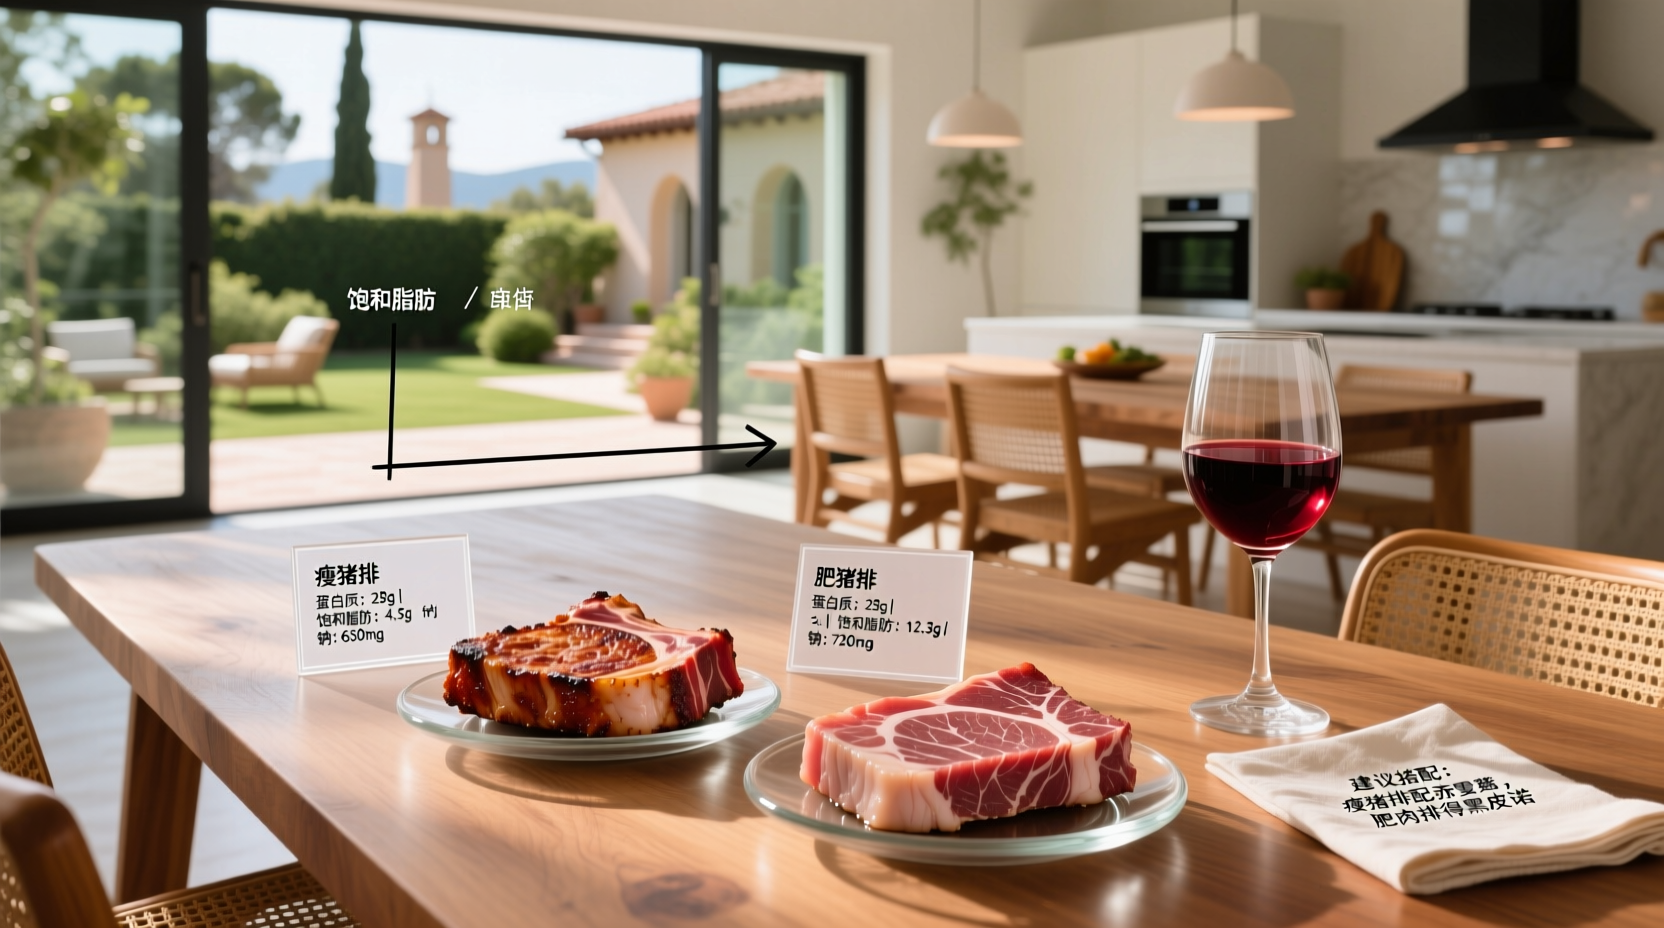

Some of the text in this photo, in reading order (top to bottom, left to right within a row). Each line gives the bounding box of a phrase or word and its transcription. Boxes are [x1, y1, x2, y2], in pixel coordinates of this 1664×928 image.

[314, 561, 380, 588] 瘦猪排
[814, 566, 878, 590] 肥猪排
